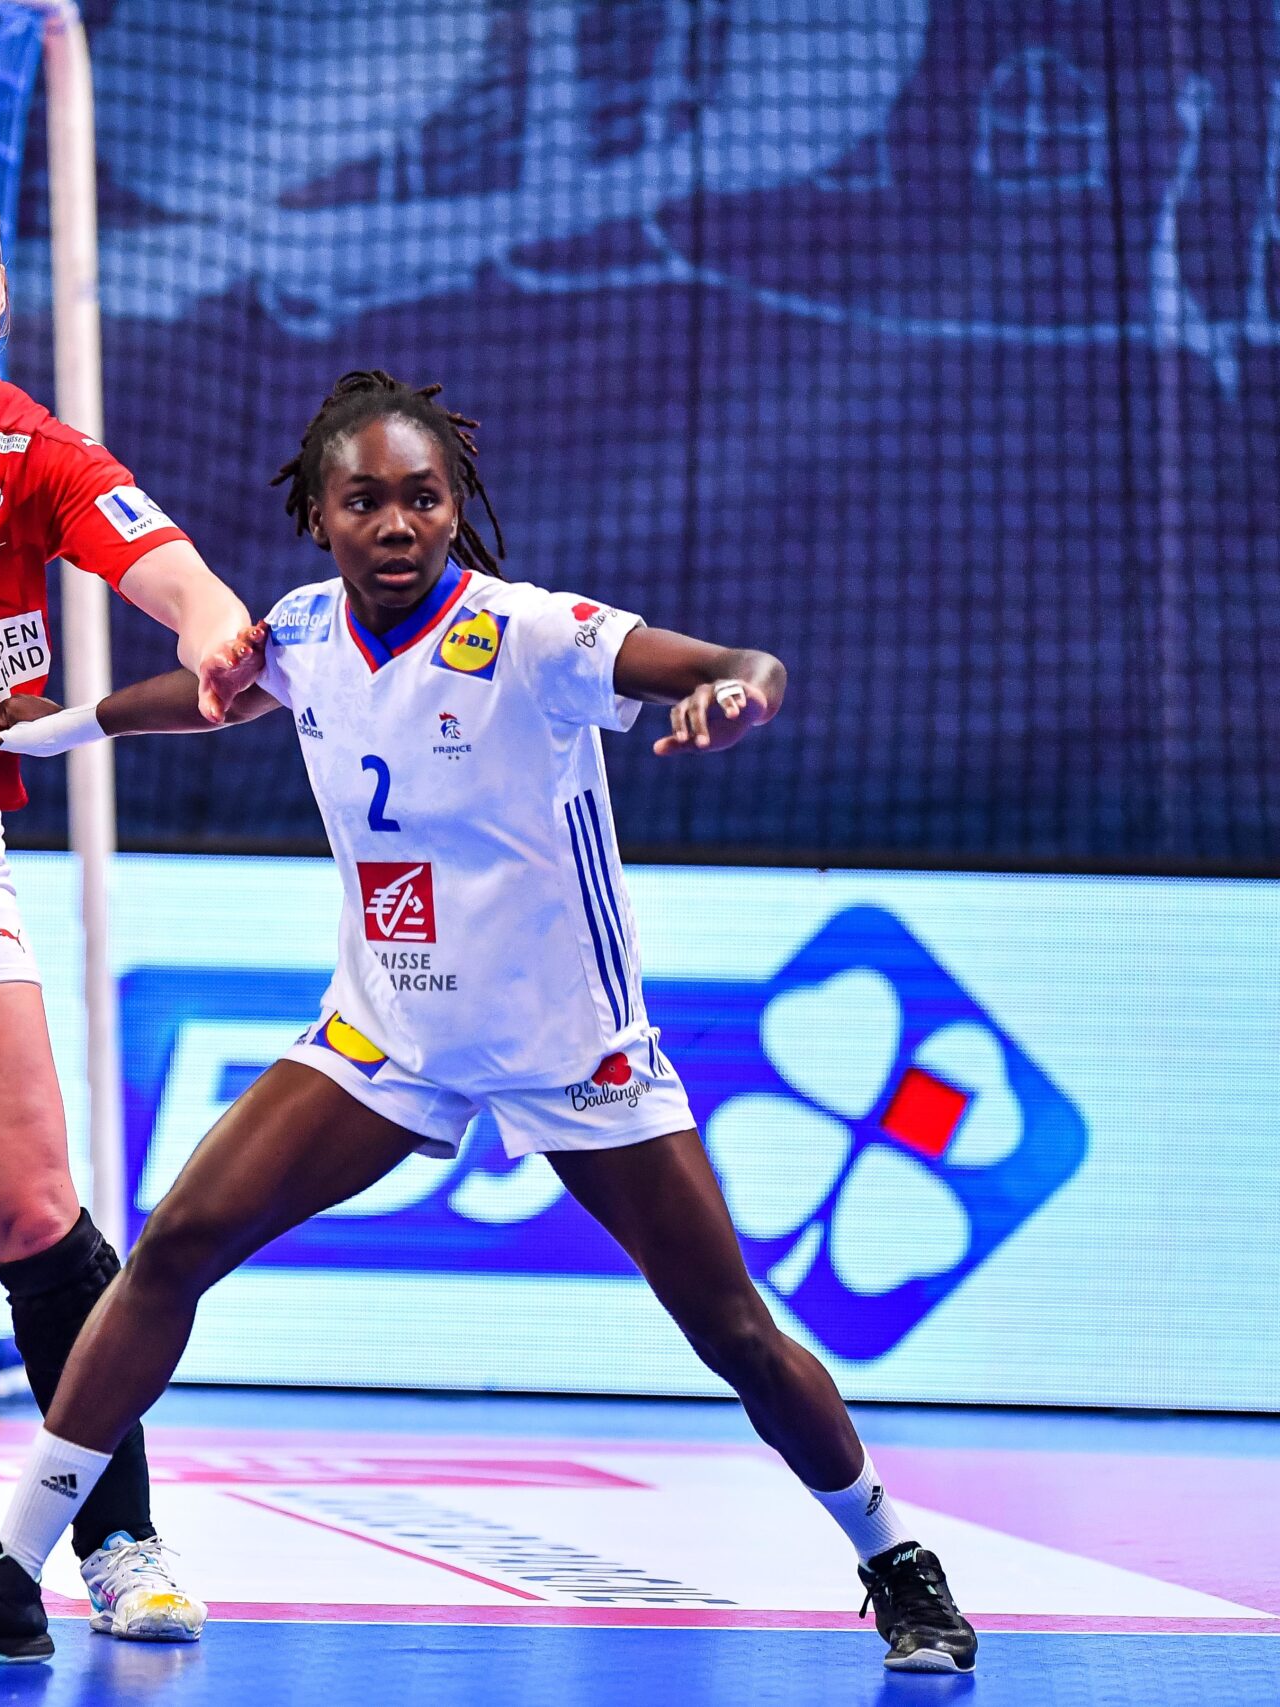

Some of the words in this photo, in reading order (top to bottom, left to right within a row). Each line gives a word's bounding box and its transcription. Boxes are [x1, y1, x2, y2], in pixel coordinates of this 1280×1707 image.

[361, 754, 401, 832] 2
[374, 951, 431, 970] AISSE
[564, 1080, 653, 1112] Boulangère
[583, 1080, 597, 1094] la
[40, 1479, 78, 1500] adidas
